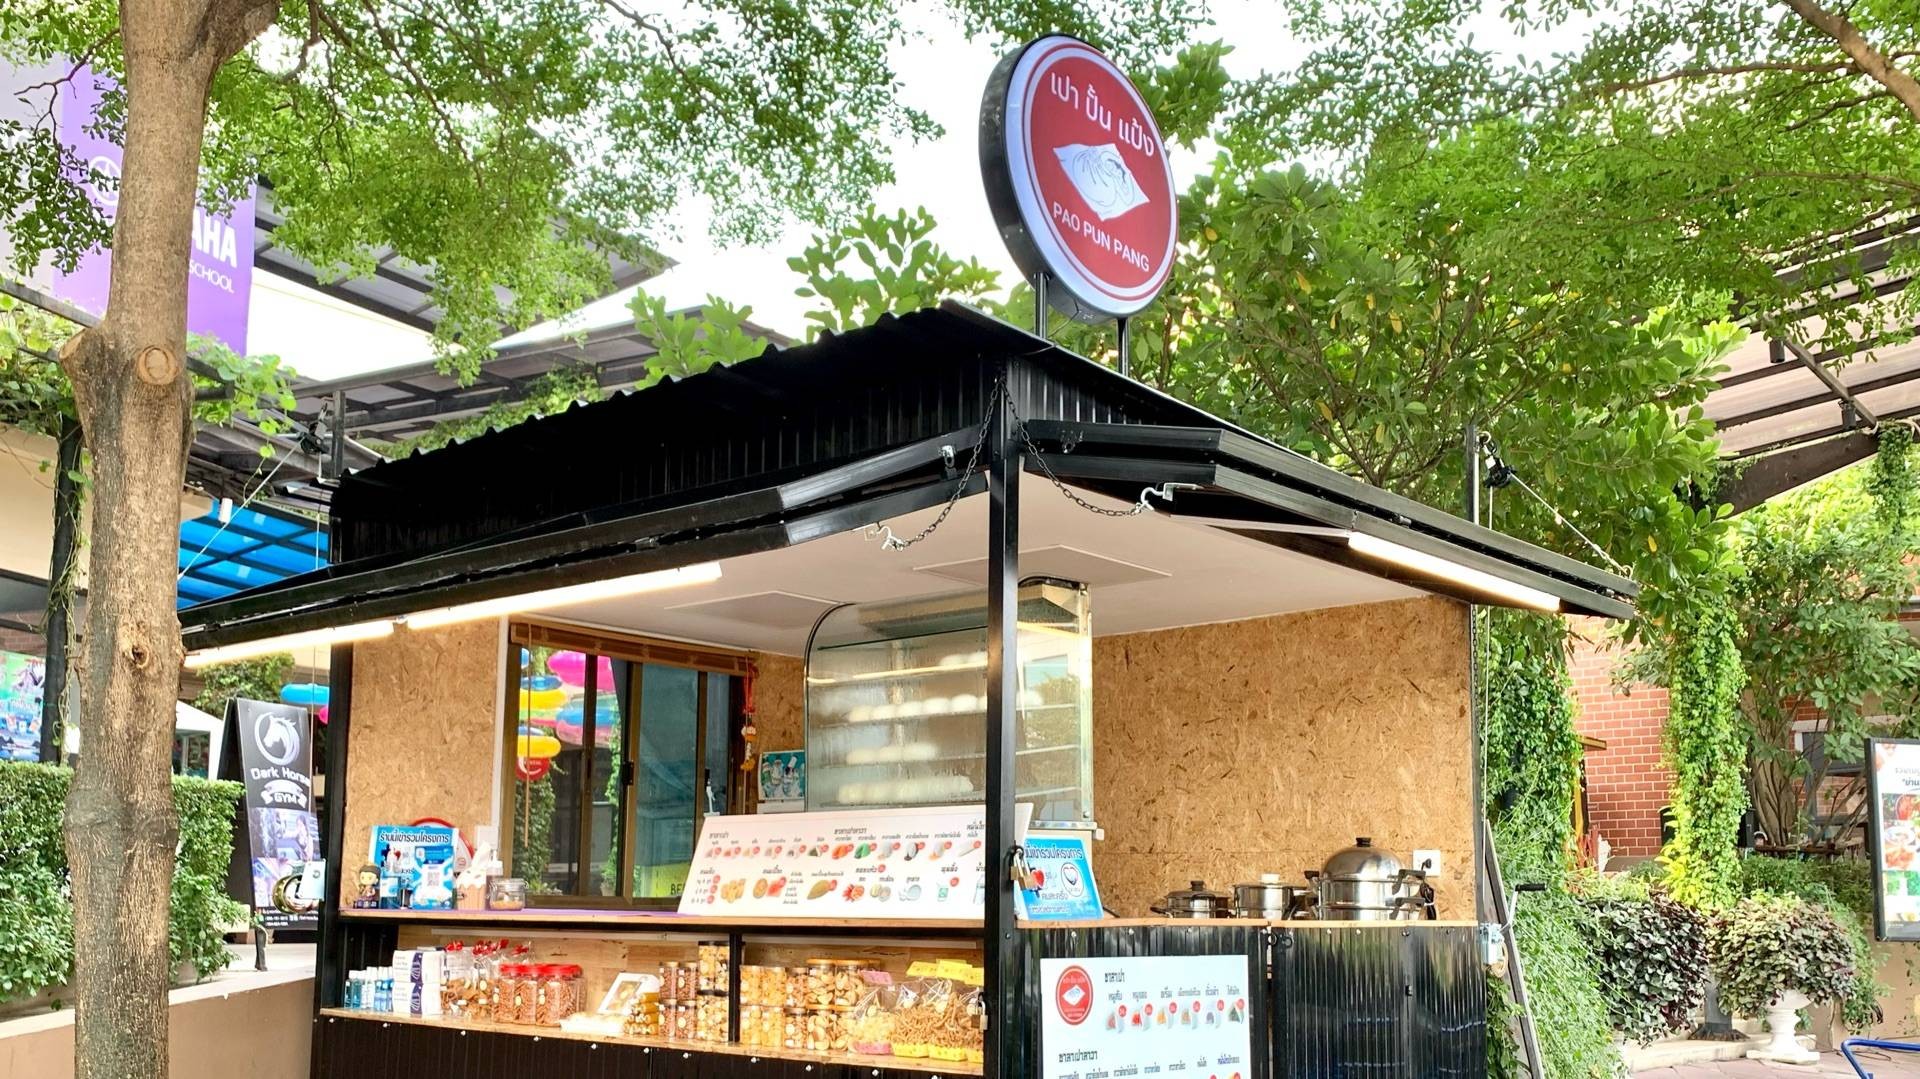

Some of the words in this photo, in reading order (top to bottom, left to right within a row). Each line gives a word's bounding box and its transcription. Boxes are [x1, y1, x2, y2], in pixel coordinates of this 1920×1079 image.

[1051, 72, 1079, 110] เปา
[1085, 83, 1112, 132] ปั้น
[1118, 117, 1155, 157] แป้ง
[1053, 201, 1081, 233] PAO
[1083, 220, 1112, 252] PUN
[1113, 238, 1150, 272] PANG
[189, 259, 235, 294] SCHOOL
[250, 766, 280, 780] Dark
[273, 791, 298, 804] GYM
